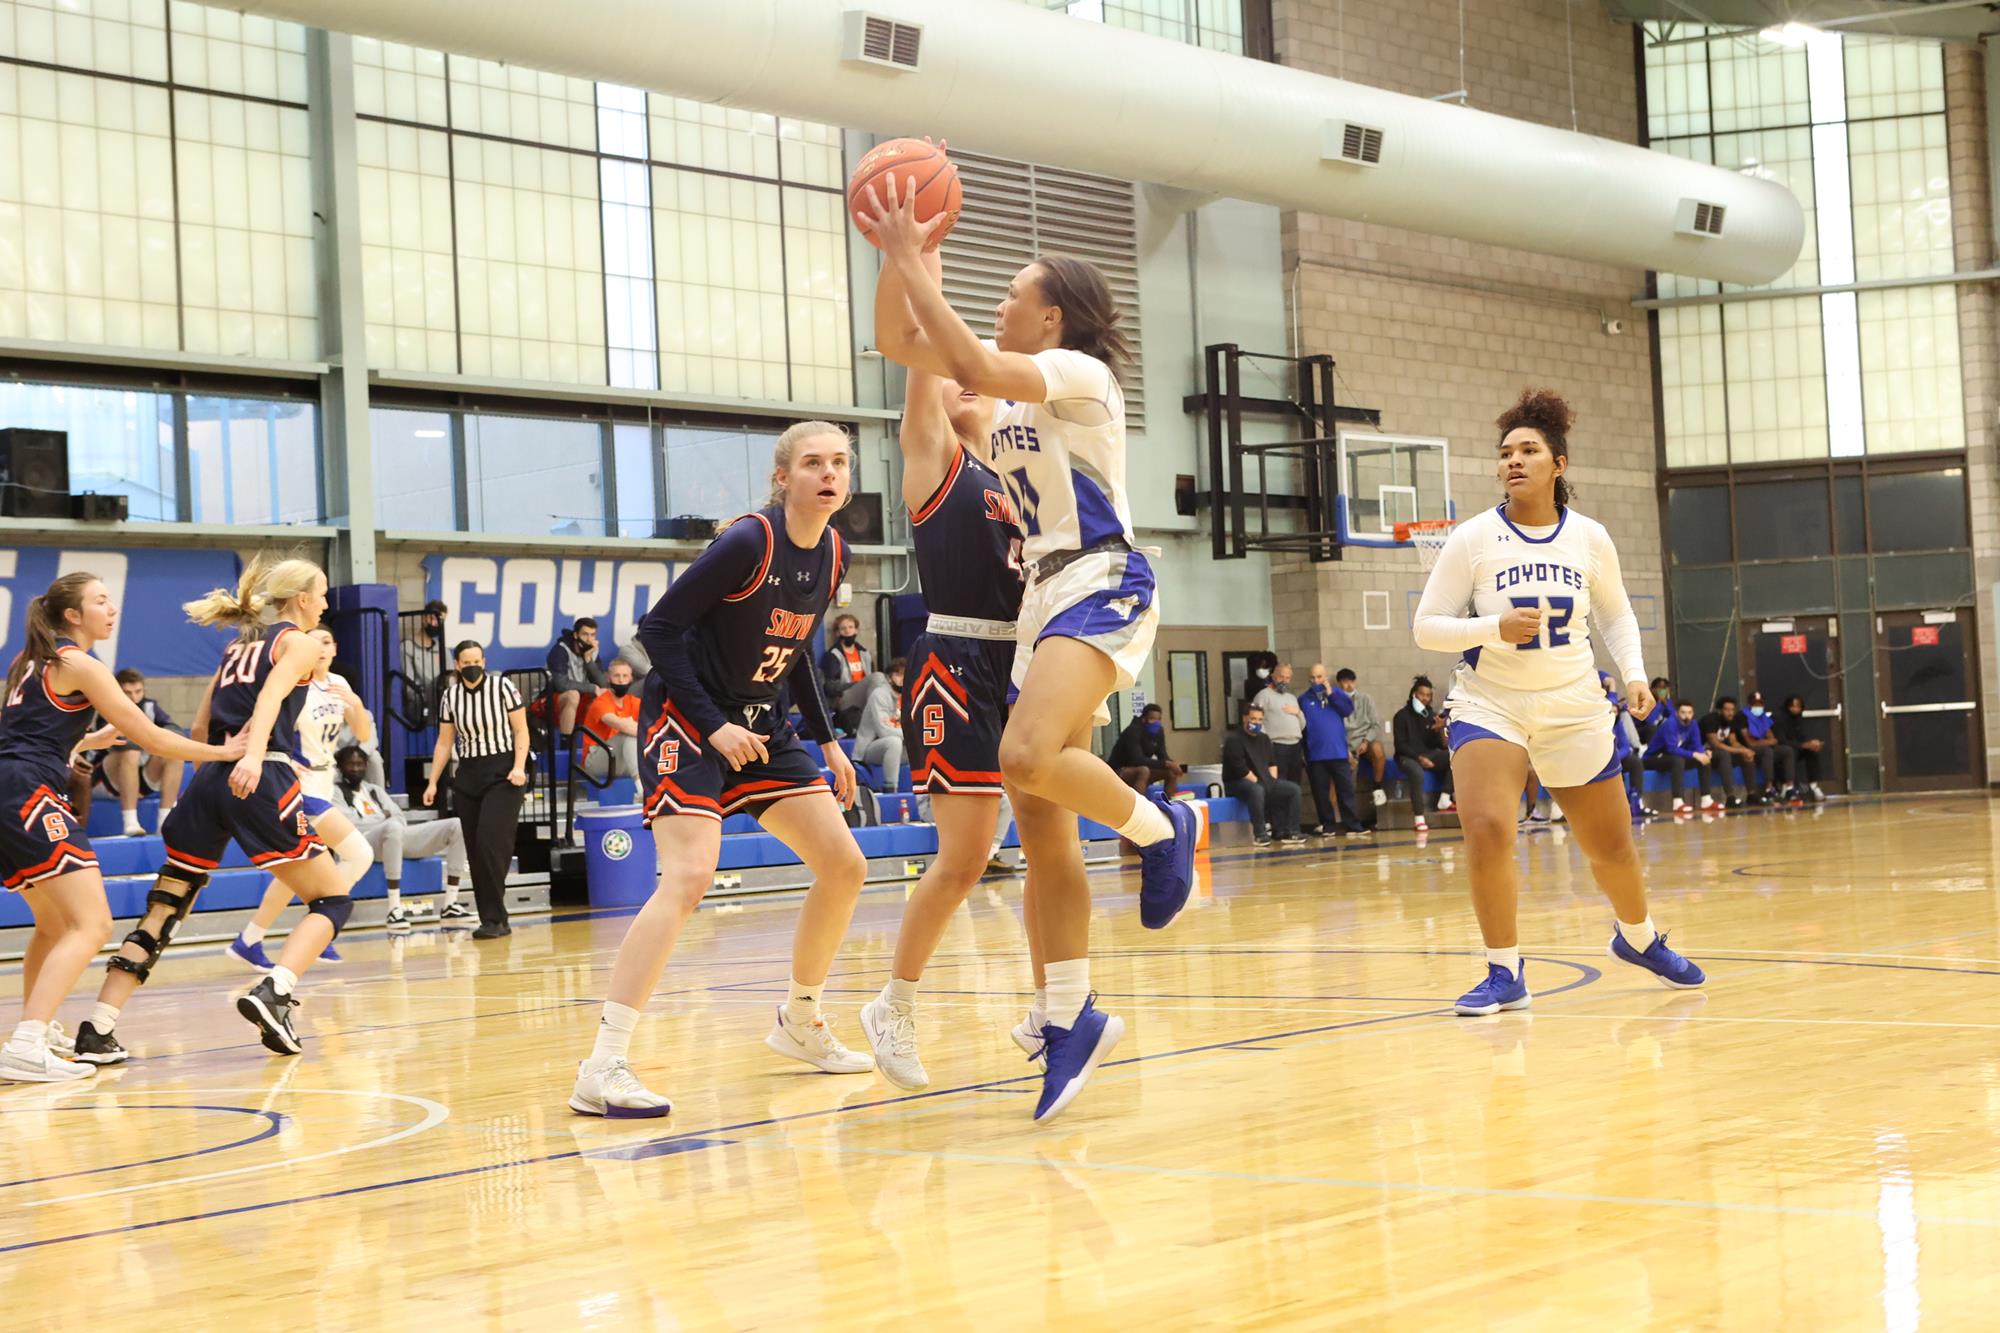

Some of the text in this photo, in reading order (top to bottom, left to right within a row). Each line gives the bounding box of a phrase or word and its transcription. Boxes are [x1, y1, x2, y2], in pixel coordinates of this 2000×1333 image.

[983, 488, 1022, 527] SN
[1495, 563, 1583, 593] COYOTES
[441, 556, 692, 650] COYO
[765, 607, 817, 641] SNOW
[219, 639, 266, 689] 20
[752, 646, 795, 683] 25
[922, 704, 945, 746] S
[657, 739, 680, 775] S
[42, 811, 70, 842] S
